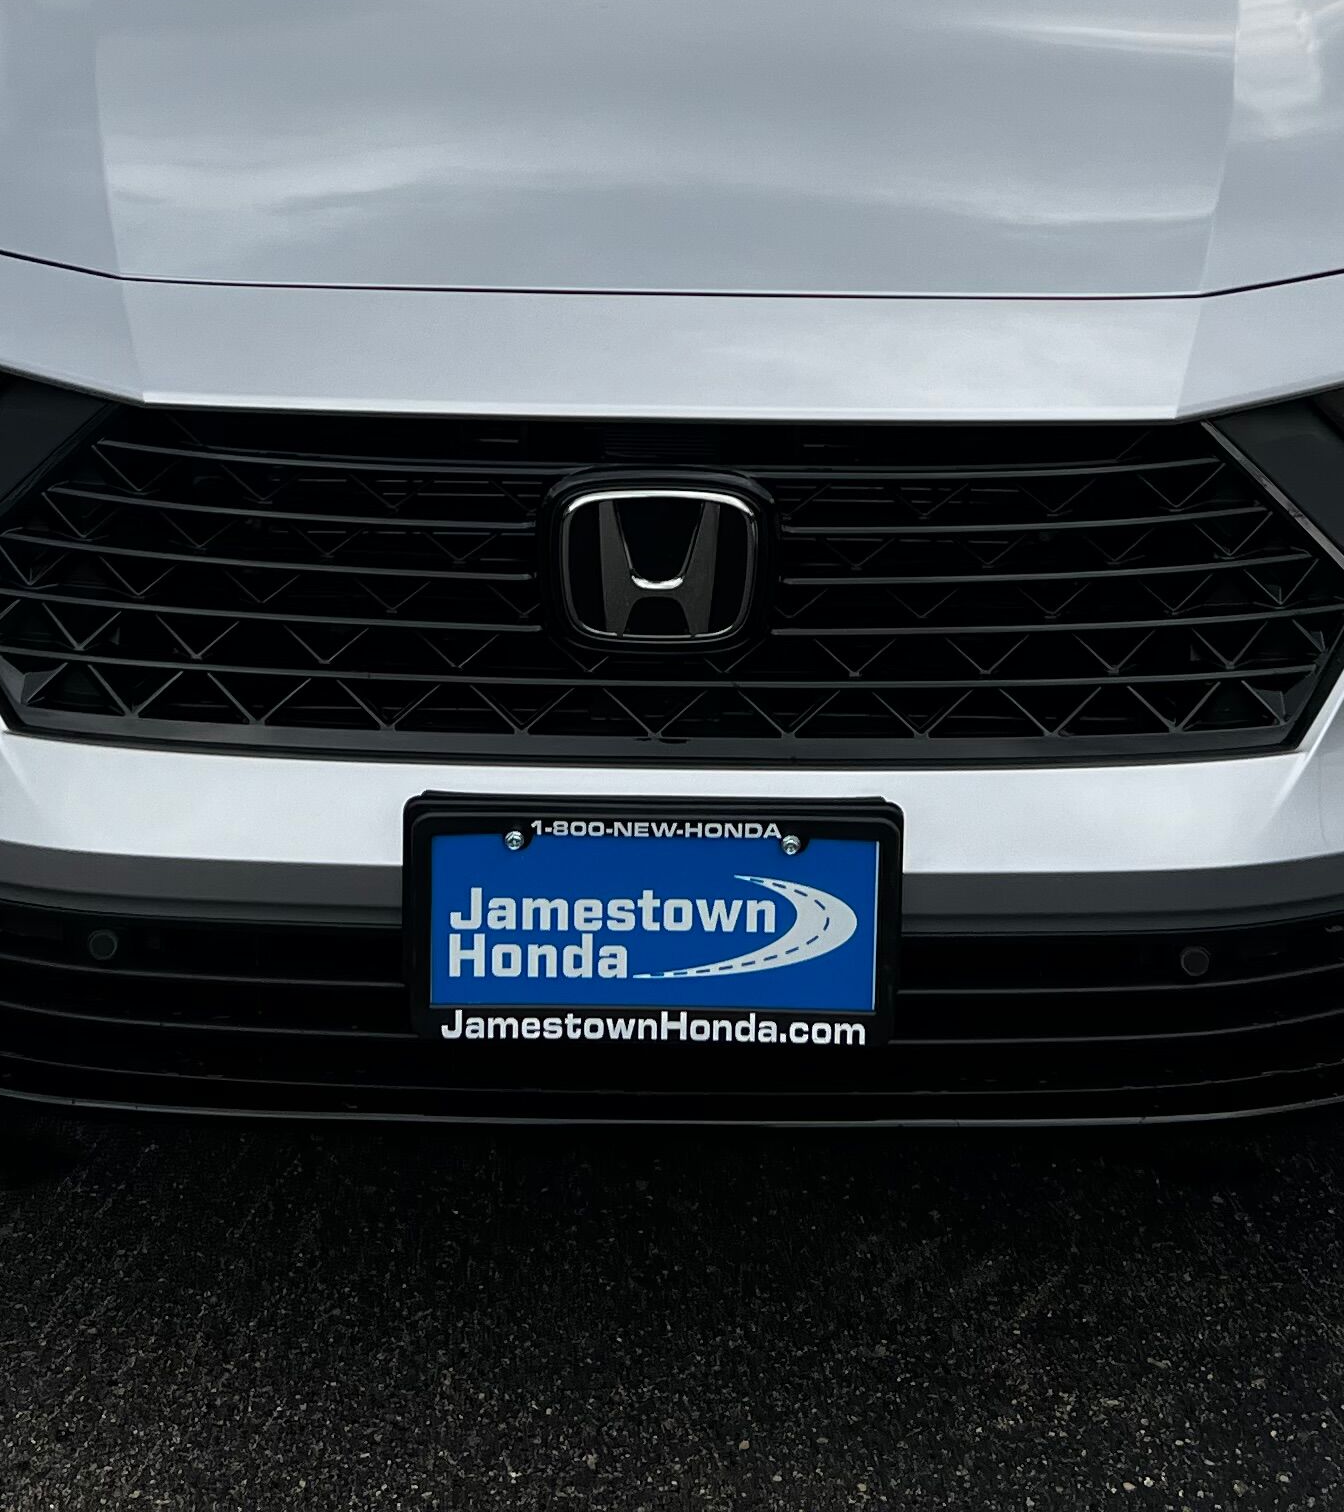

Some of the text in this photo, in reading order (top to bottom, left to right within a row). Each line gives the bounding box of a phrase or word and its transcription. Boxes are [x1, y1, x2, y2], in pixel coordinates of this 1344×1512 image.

[530, 820, 782, 840] 1-800-NEW-HONDA
[449, 887, 776, 934] Jamestown
[448, 933, 629, 979] Honda
[441, 1009, 866, 1046] JamestownHonda.com
